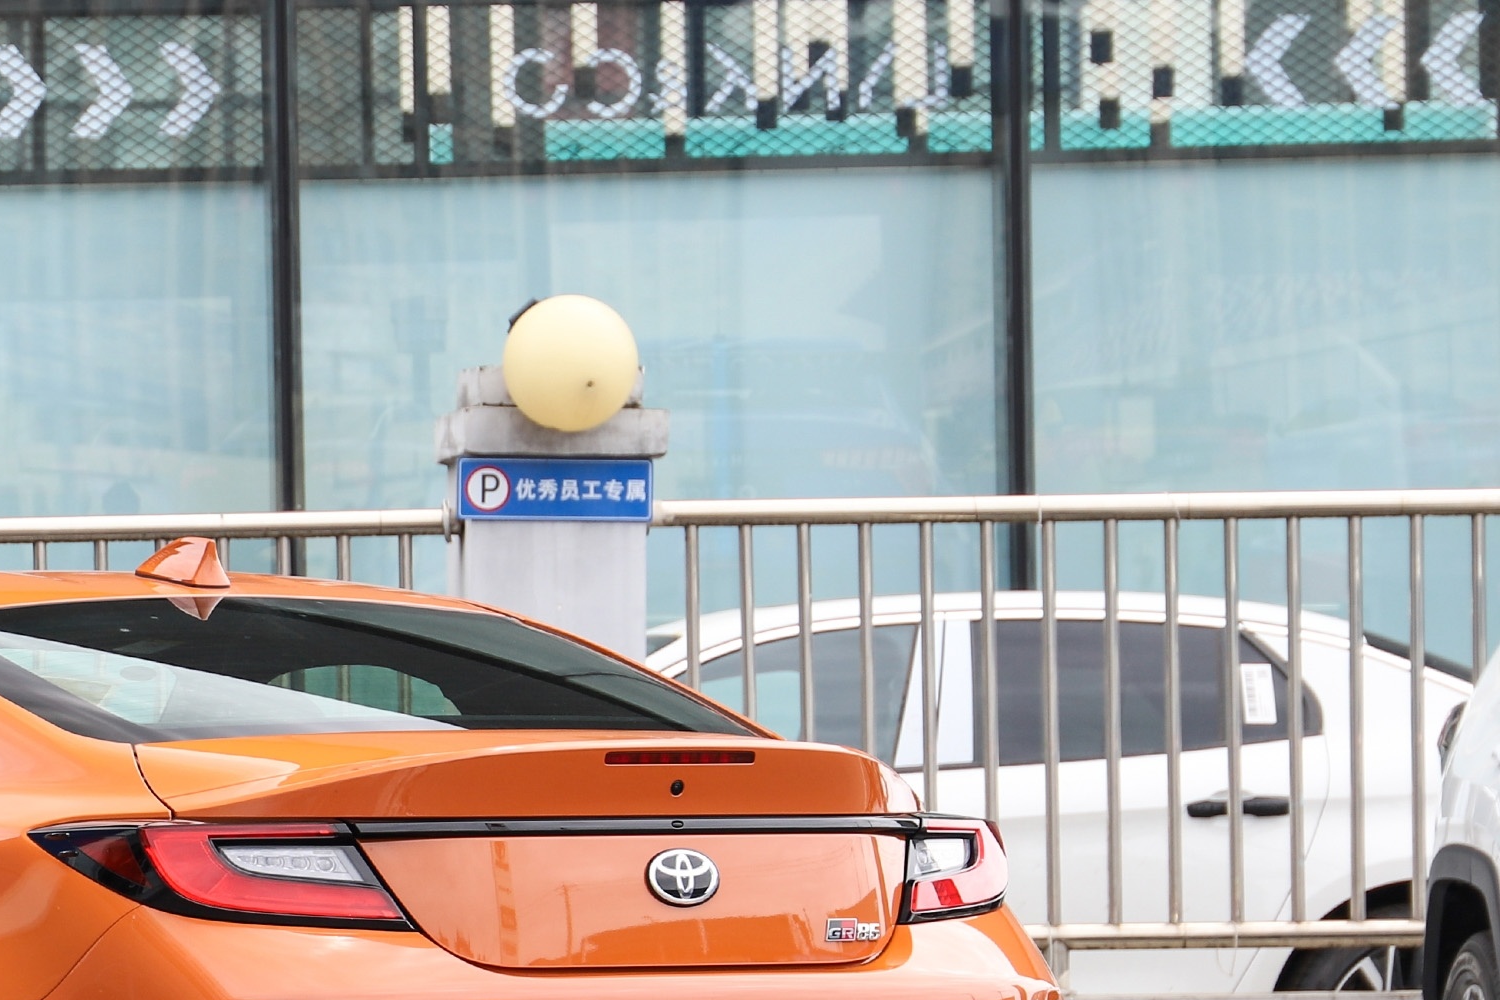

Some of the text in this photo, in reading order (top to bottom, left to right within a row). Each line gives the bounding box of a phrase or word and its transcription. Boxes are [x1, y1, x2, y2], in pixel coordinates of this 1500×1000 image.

[481, 473, 647, 504] P 优秀员工专属
